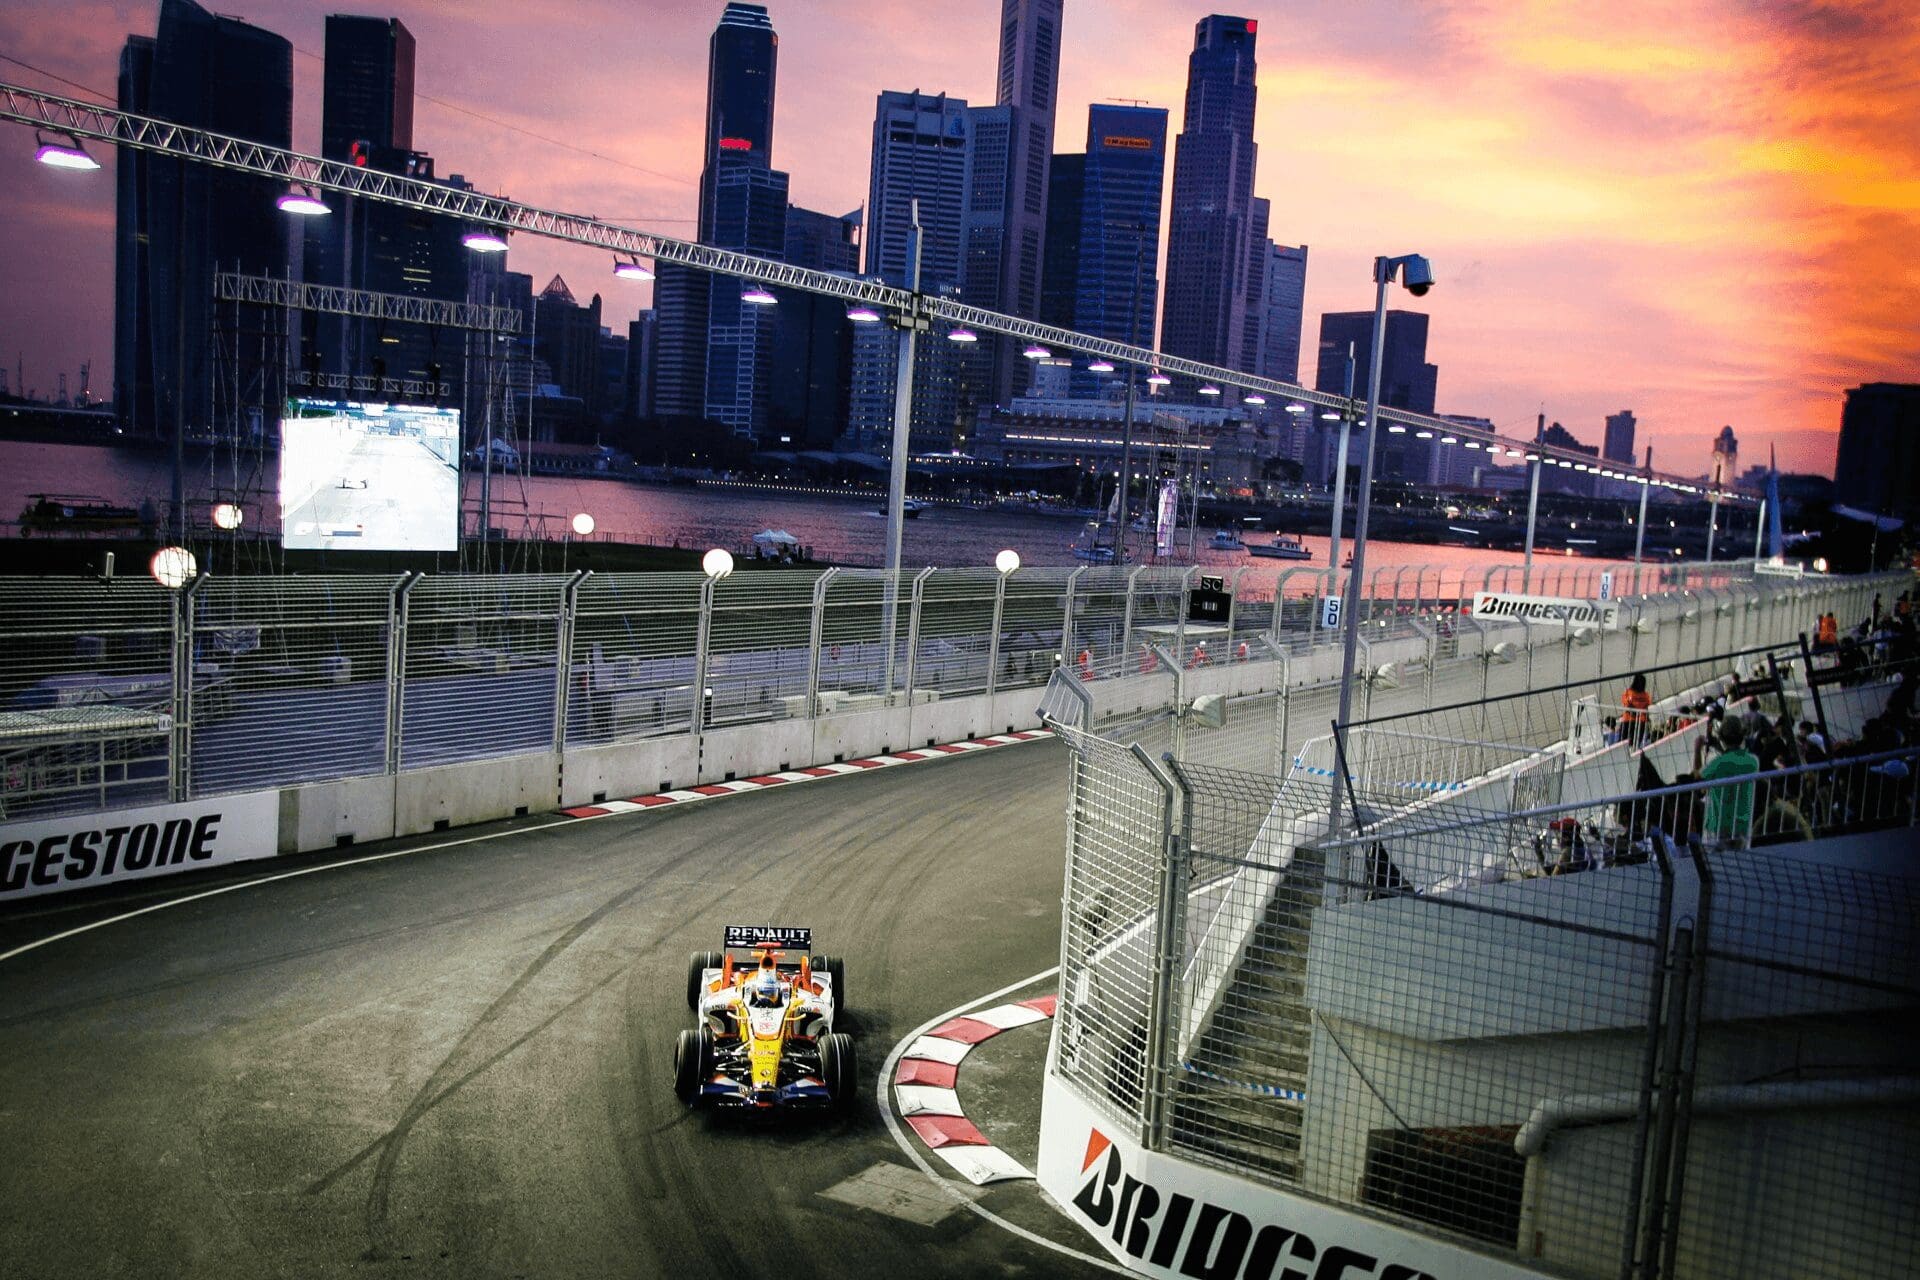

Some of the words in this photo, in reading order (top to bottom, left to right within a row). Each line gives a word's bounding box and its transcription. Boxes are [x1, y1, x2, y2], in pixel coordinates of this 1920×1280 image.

[1202, 579, 1221, 590] SC
[1328, 600, 1339, 625] 50
[0, 814, 222, 892] GESTONE
[729, 927, 808, 941] RENAULT
[1072, 1127, 1437, 1280] BRIDG
